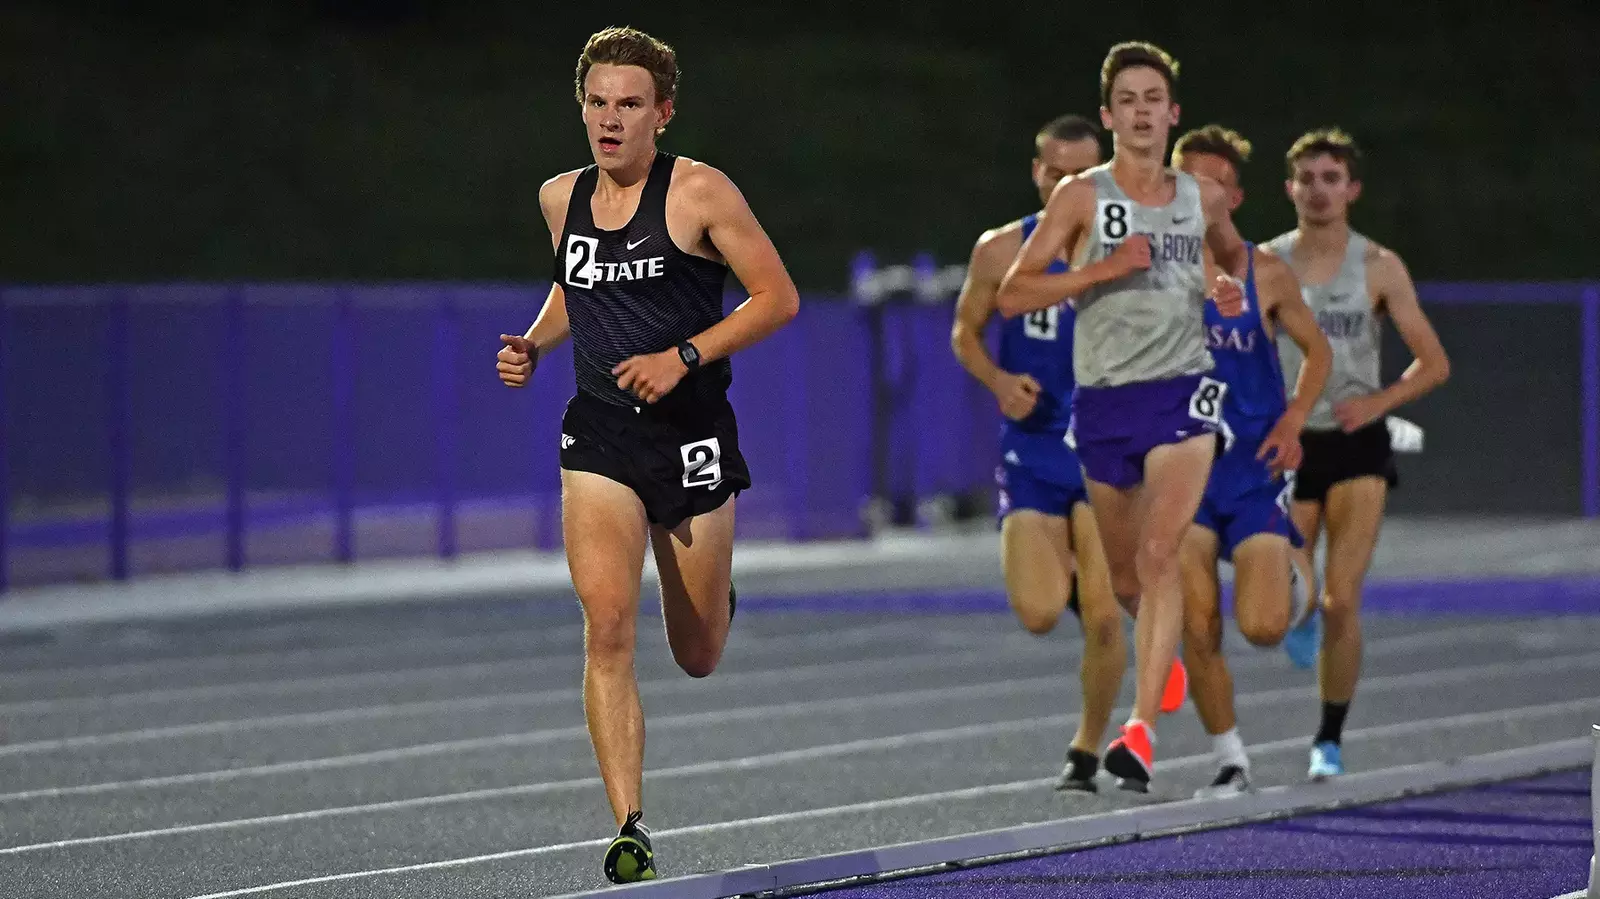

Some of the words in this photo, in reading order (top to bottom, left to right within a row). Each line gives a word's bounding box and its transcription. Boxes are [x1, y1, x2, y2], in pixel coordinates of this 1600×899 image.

[1104, 204, 1128, 239] 8
[569, 240, 591, 286] 2
[594, 257, 665, 282] STATE
[1030, 308, 1049, 334] 4
[1195, 384, 1220, 417] 8
[687, 445, 715, 484] 2
